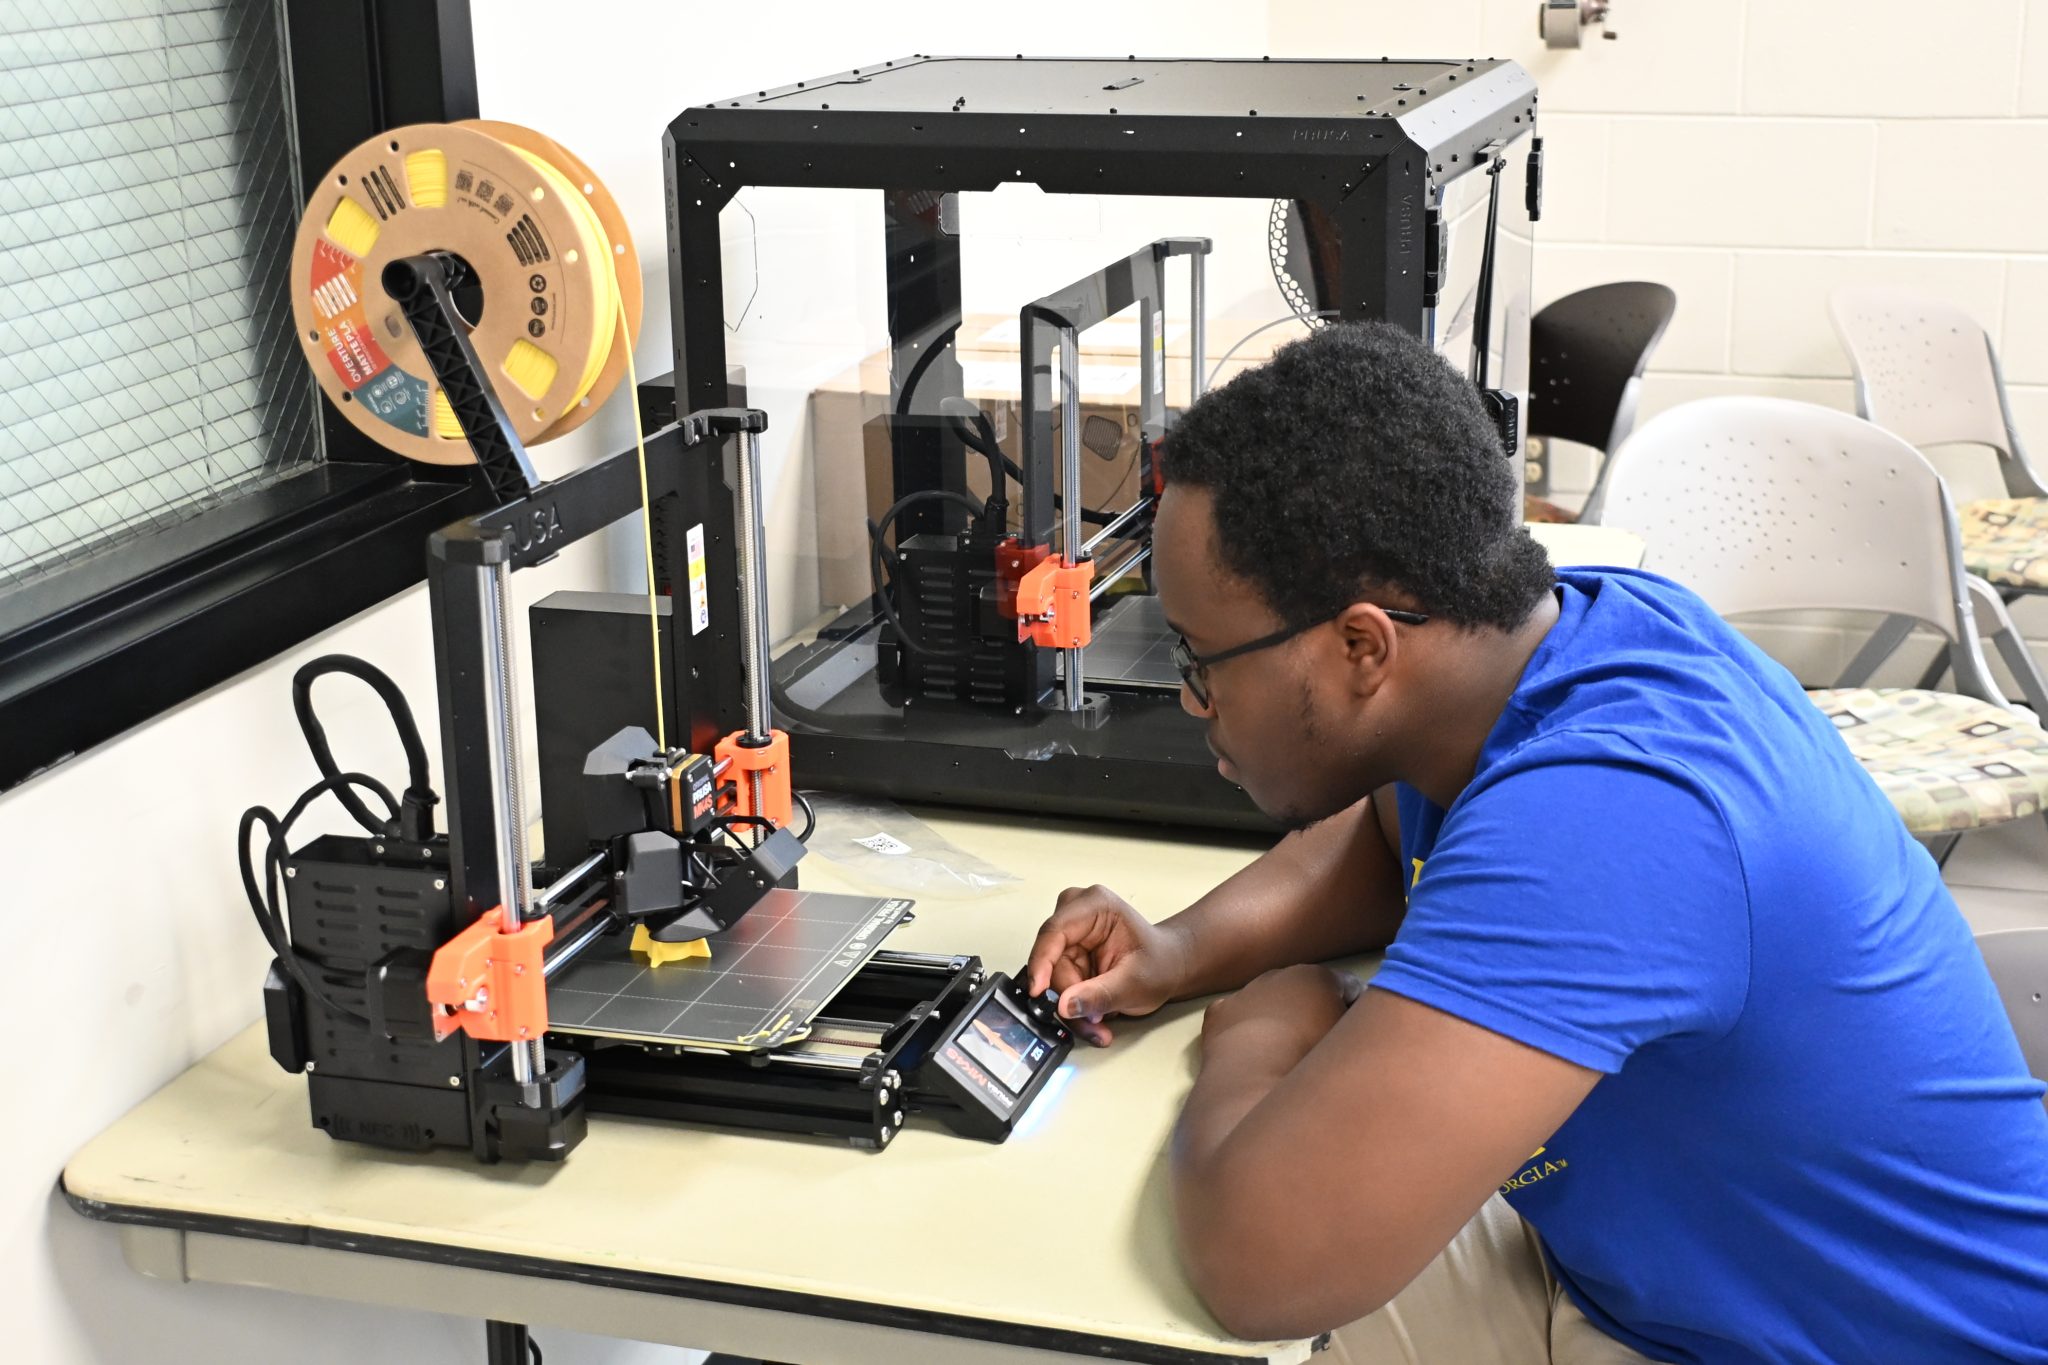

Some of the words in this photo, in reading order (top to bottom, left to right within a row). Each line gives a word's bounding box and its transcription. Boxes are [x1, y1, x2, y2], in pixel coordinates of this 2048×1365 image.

[1400, 193, 1412, 254] PRUSA
[340, 320, 355, 343] PLA
[328, 328, 362, 383] OVERTURE
[349, 340, 374, 376] MATTE
[692, 781, 712, 805] PRUSA
[946, 1047, 988, 1087] MK4S
[359, 1122, 395, 1138] NFC
